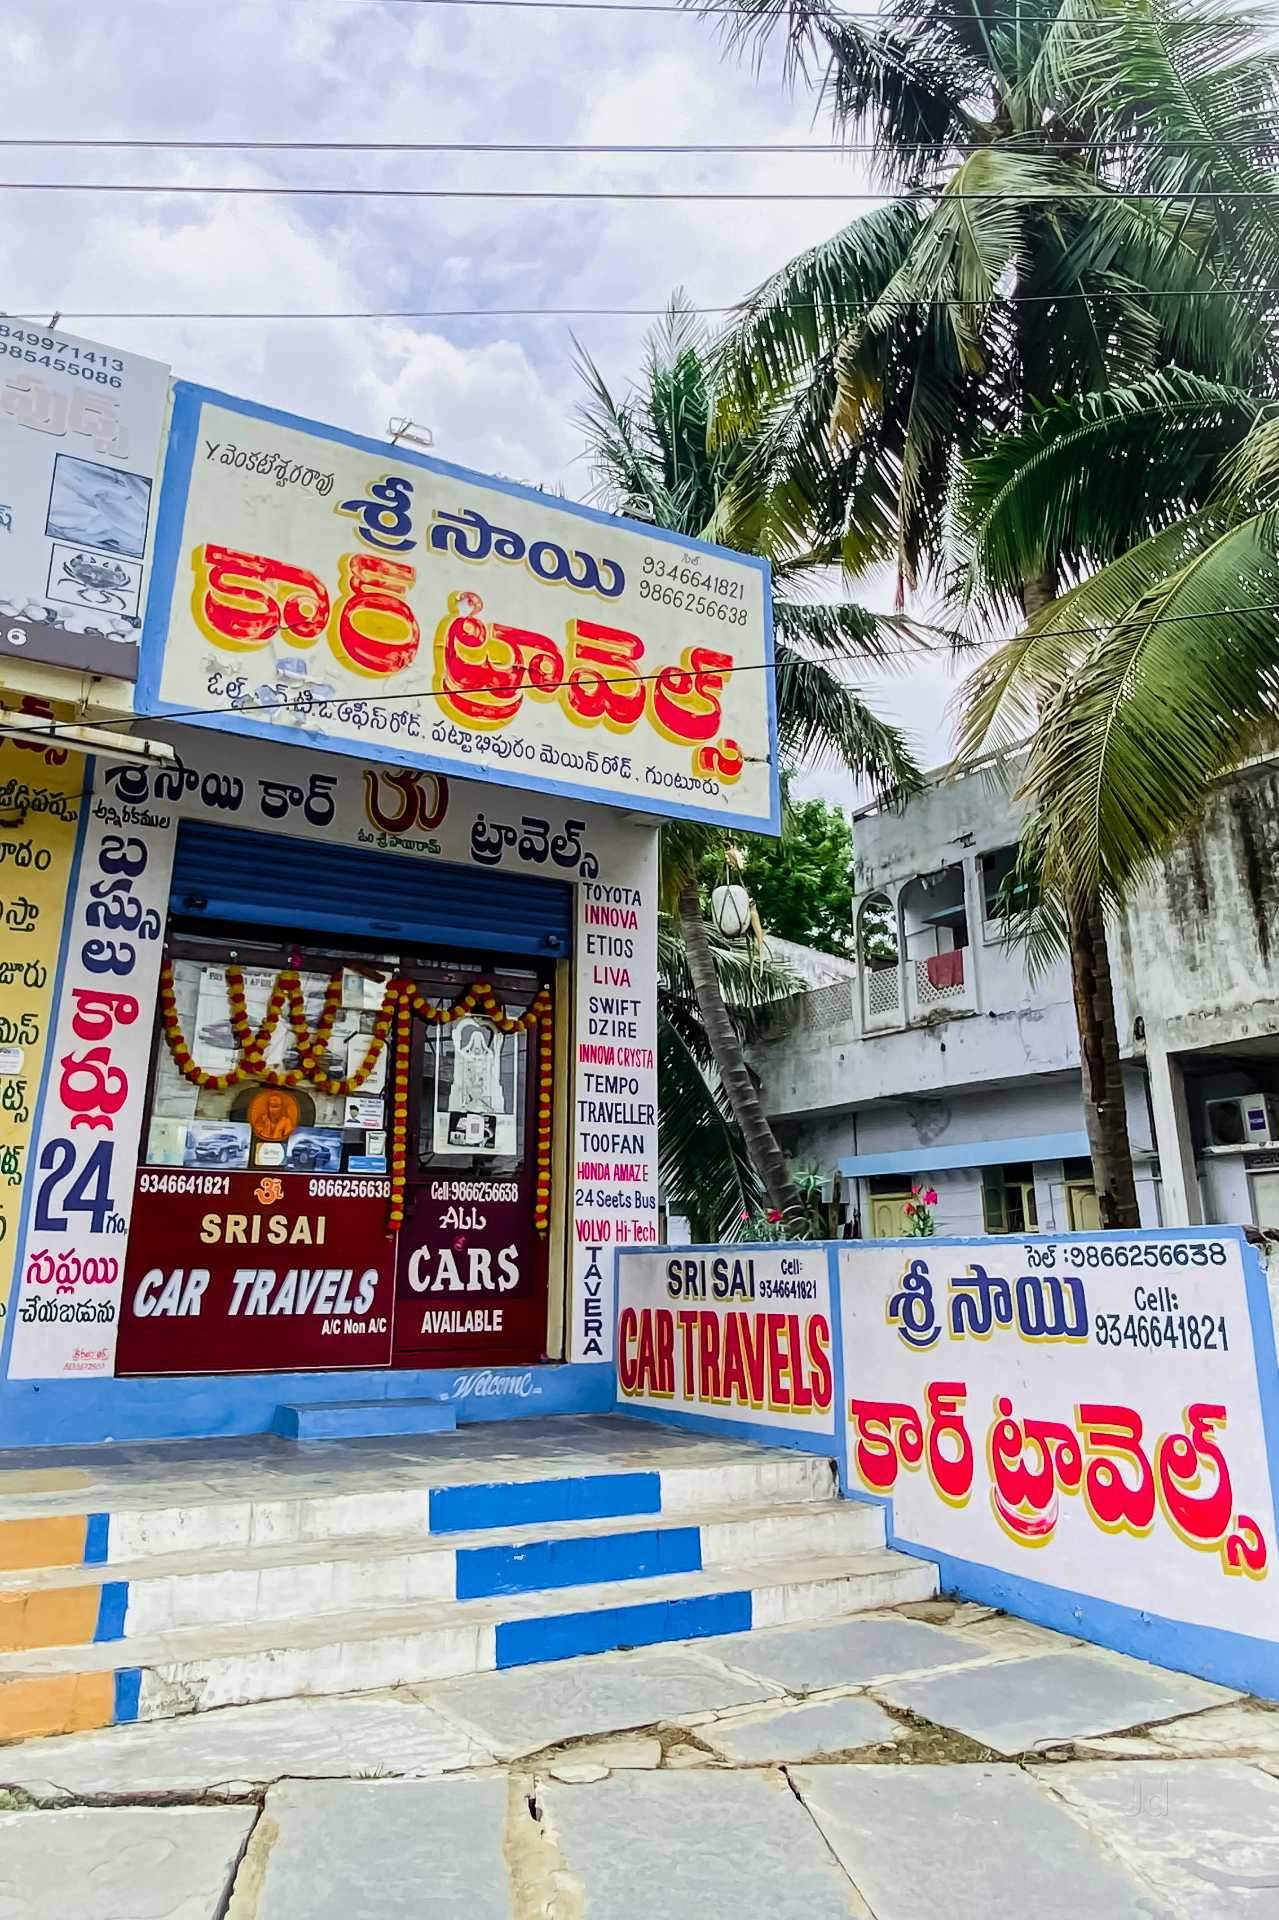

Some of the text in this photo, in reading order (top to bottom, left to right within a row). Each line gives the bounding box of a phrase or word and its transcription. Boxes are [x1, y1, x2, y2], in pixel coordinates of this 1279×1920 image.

[335, 475, 626, 600] శ్రీ సాయి
[641, 556, 745, 601] 9346641821
[193, 543, 421, 677] కార్
[639, 580, 748, 626] 9866256638
[258, 774, 338, 827] కార్
[470, 813, 600, 880] ట్రావెల్స్
[583, 882, 642, 907] TOYOTA
[584, 904, 638, 930] INNOVA
[587, 934, 634, 959] ETIOS
[593, 965, 631, 988] LIVA
[589, 996, 641, 1017] SWIFT
[589, 1018, 637, 1039] DZIRE
[579, 1043, 654, 1069] INNOVA CRYSTA
[584, 1072, 639, 1095] TEMPO
[577, 1100, 655, 1125] TRAVELLER
[580, 1132, 645, 1154] TOOFAN
[139, 1174, 230, 1194] 9346641821
[577, 1162, 649, 1182] HONDA AMAZE
[34, 1138, 115, 1234] 24
[308, 1178, 391, 1198] 9866256638
[575, 1188, 656, 1209] 24 Seets Bus
[439, 1206, 487, 1230] ALL
[575, 1219, 656, 1243] VOLVO Hi-Tech
[408, 1244, 520, 1293] CARS
[668, 1257, 755, 1299] SRI SAI
[133, 1268, 379, 1317] CAR TRAVELS
[583, 1246, 603, 1356] TAVERA
[759, 1279, 817, 1299] 9346641821
[1135, 1286, 1179, 1312] Cell:
[887, 1258, 1089, 1350] శ్రీ సాయి
[321, 1317, 387, 1335] A/C Non A/C
[421, 1309, 504, 1334] AVAILABLE
[1095, 1314, 1229, 1352] 9346641821
[619, 1307, 833, 1414] CAR TRAVELS
[849, 1381, 1268, 1581] కార్ ట్రావెల్స్
